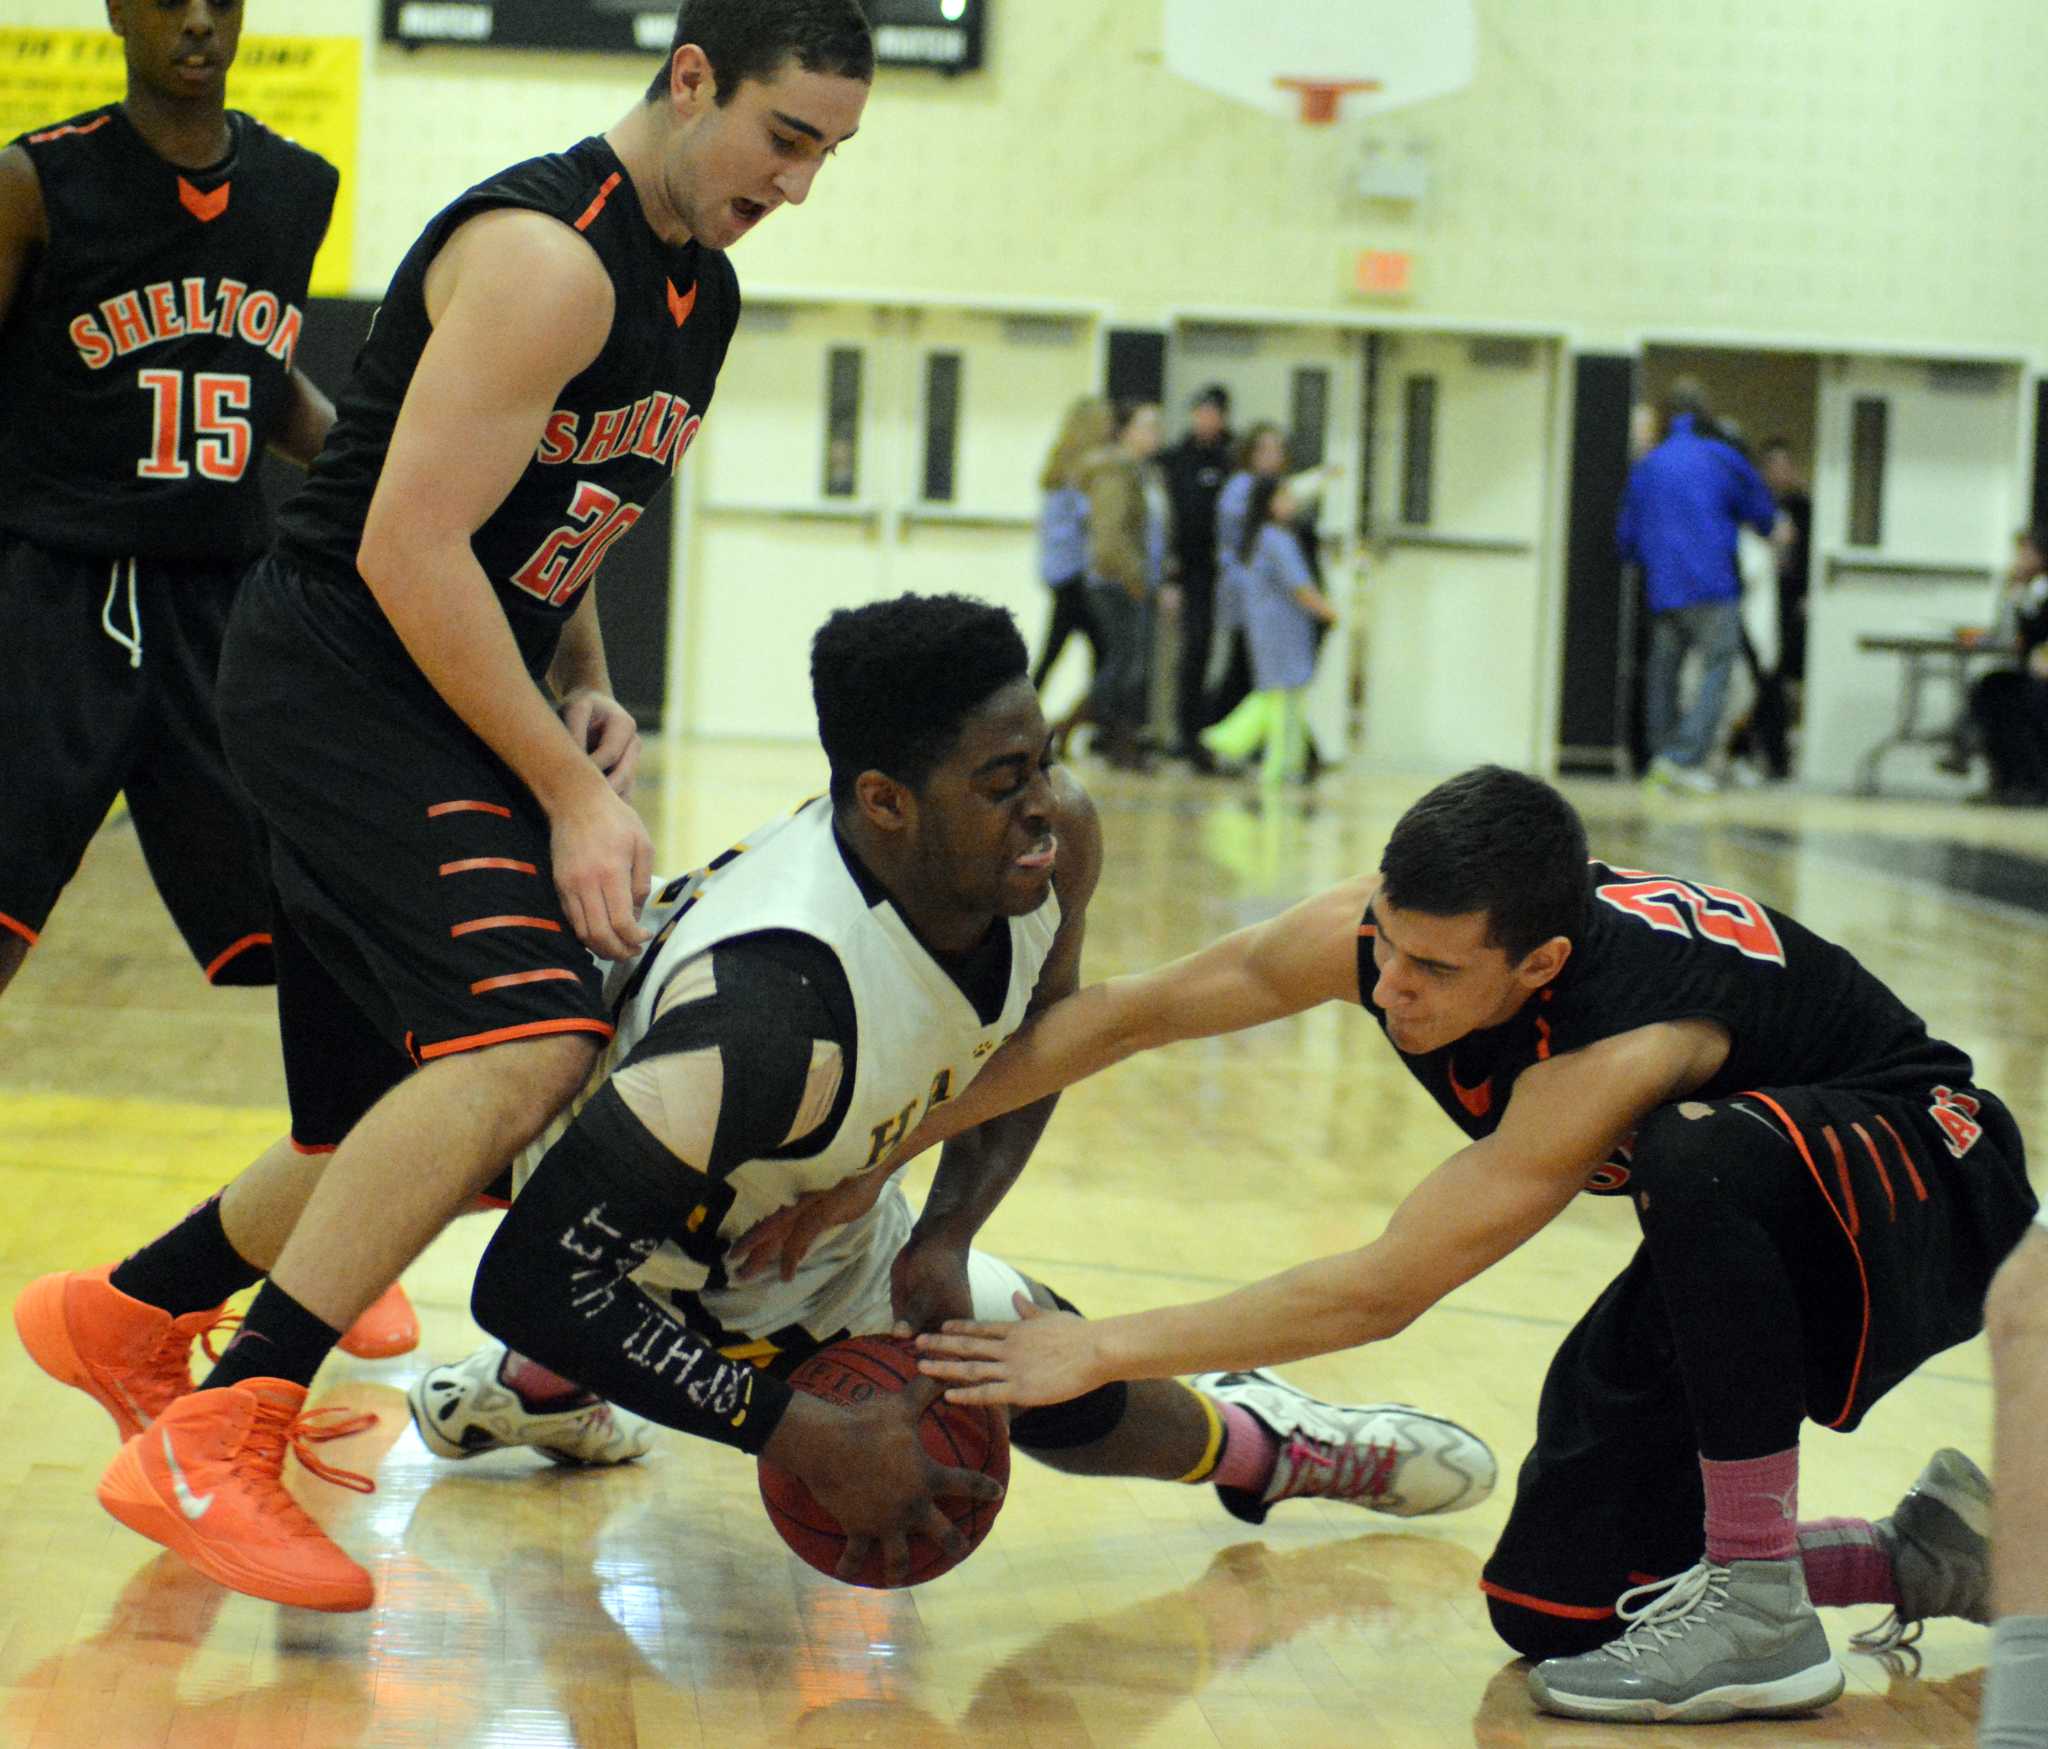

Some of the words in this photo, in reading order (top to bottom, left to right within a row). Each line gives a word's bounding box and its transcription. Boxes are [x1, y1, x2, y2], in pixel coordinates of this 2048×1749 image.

[69, 277, 303, 374] SHELTON
[137, 368, 253, 483] 15
[509, 480, 646, 608] 20
